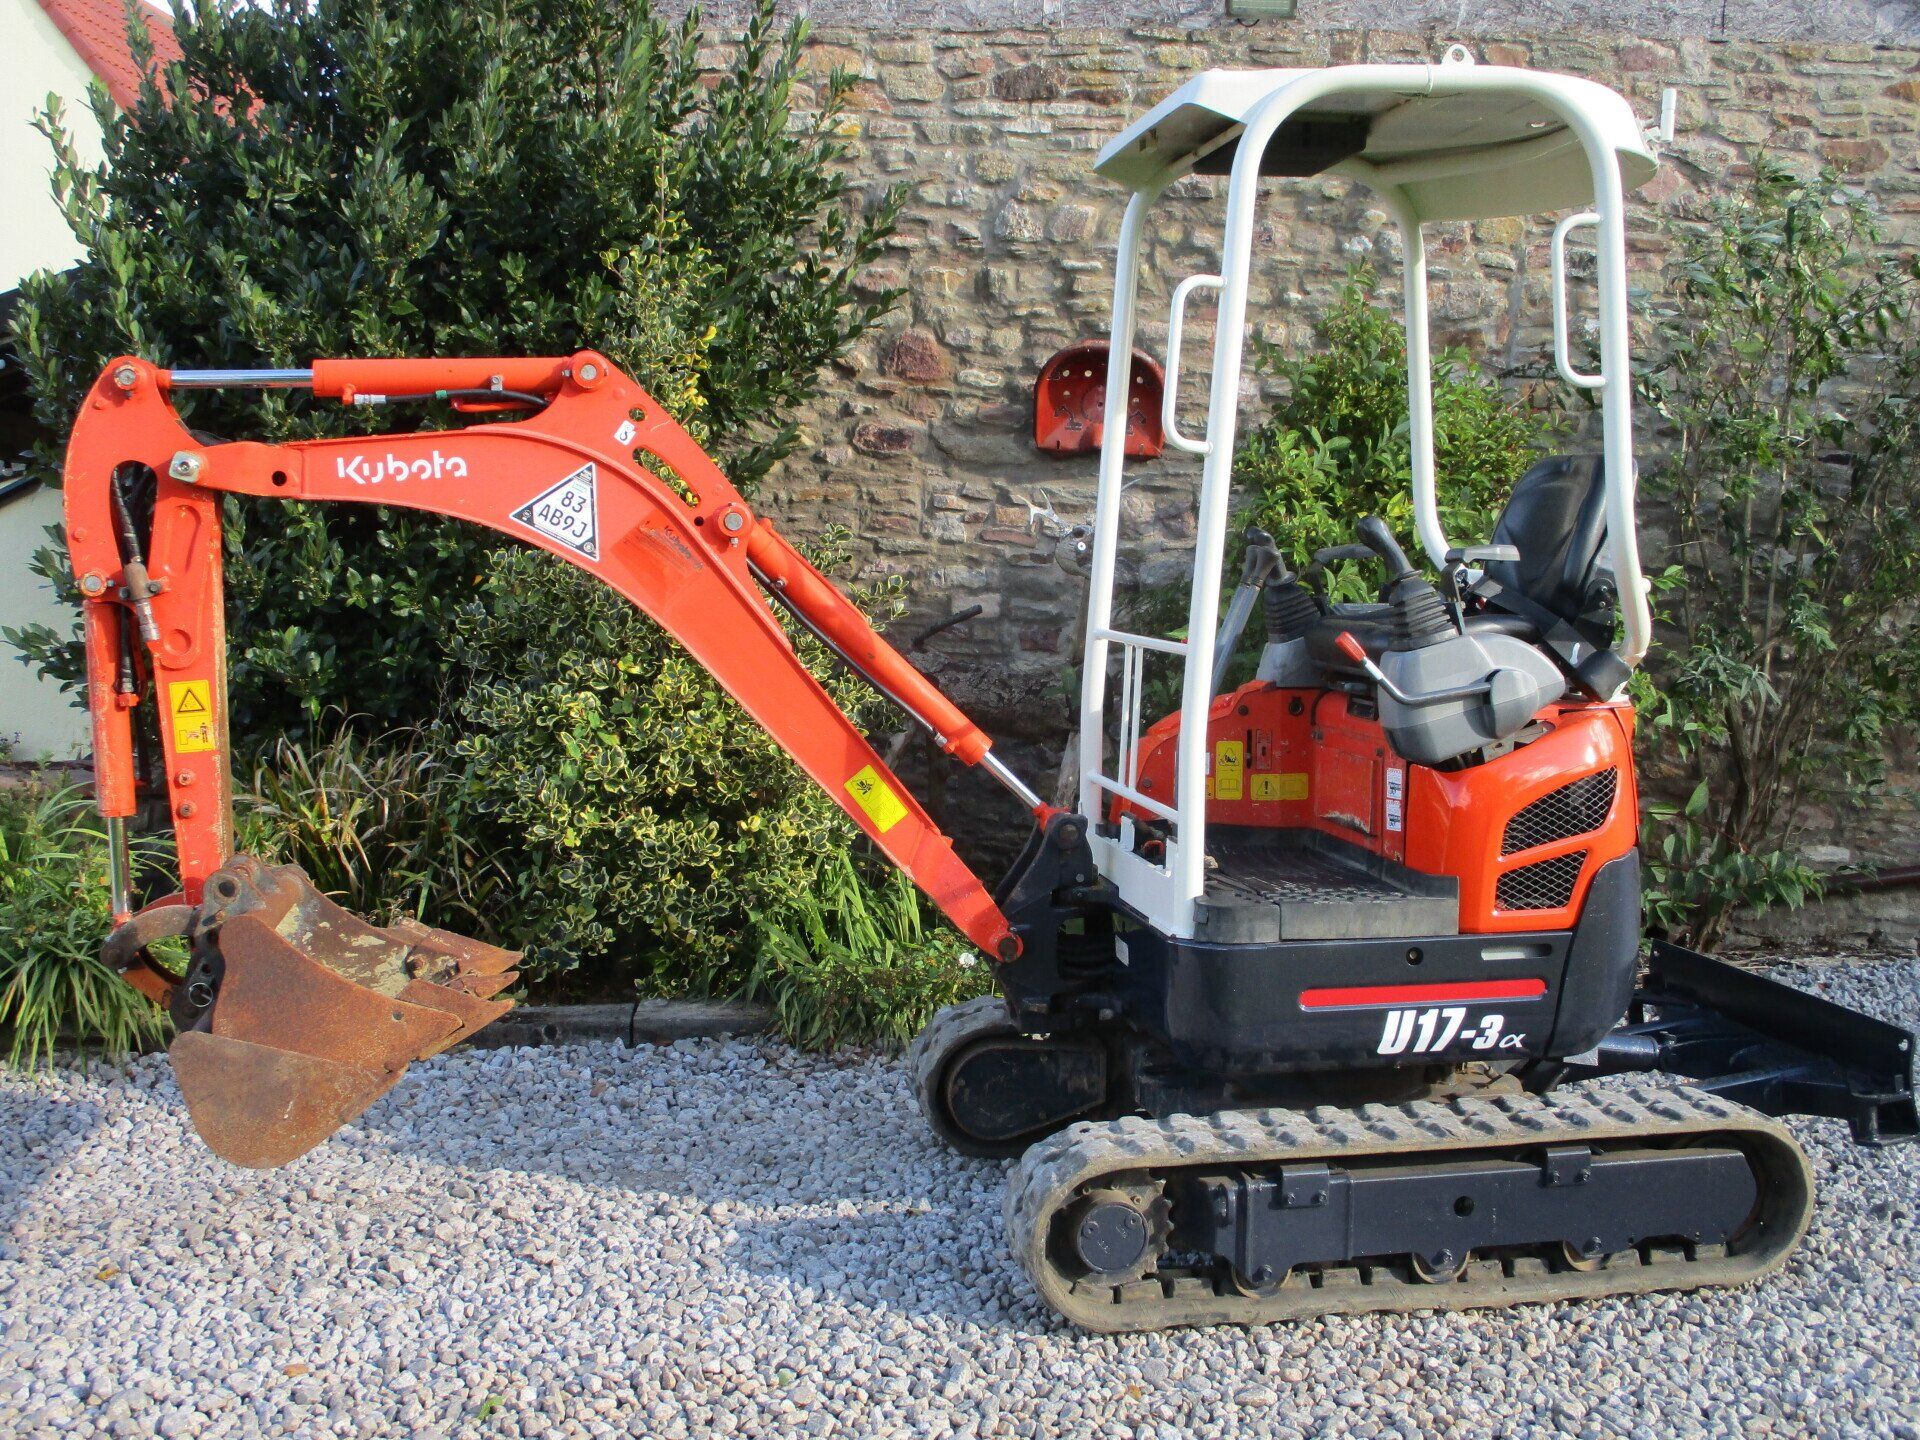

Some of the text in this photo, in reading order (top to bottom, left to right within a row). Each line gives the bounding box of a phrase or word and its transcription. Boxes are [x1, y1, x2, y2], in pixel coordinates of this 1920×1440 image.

[336, 450, 468, 485] Kubota
[561, 490, 587, 513] 83
[538, 504, 588, 538] AB9J
